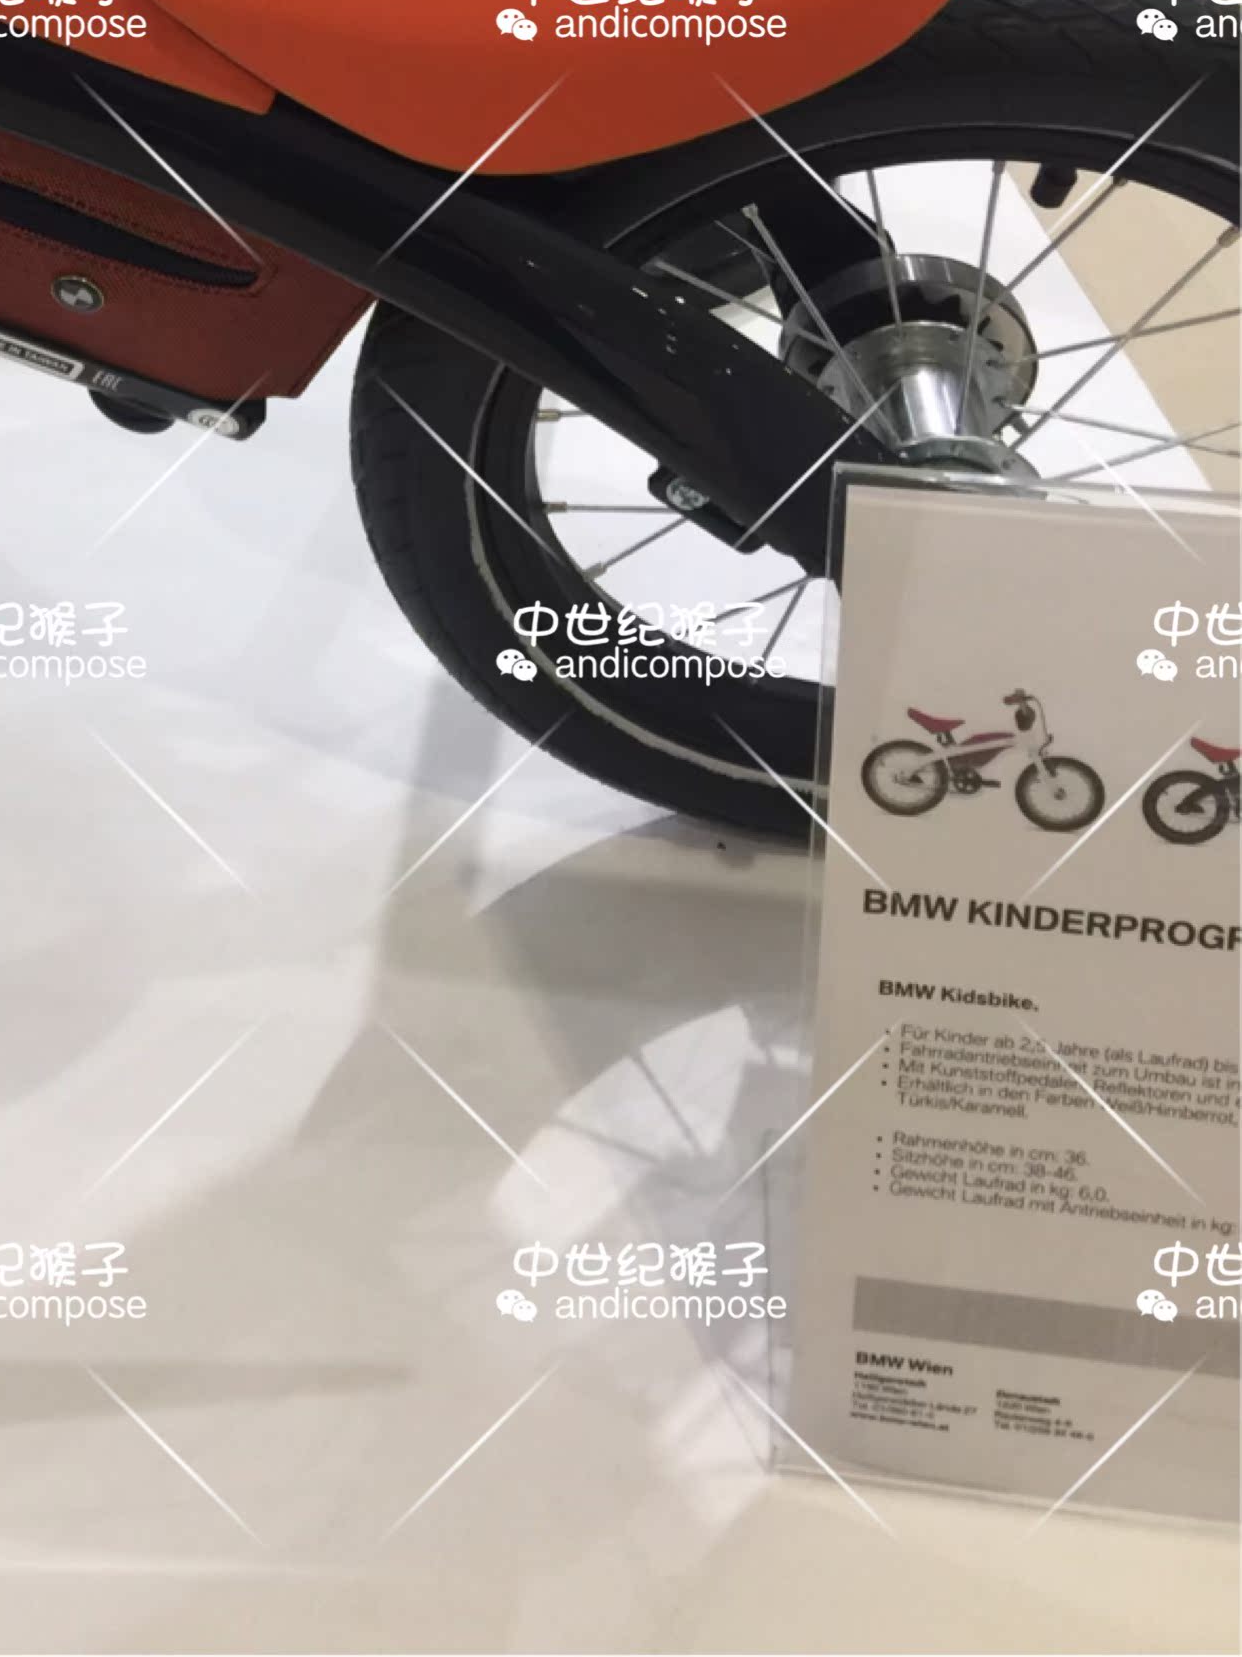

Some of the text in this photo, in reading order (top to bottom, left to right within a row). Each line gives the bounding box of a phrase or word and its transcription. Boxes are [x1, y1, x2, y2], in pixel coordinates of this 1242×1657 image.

[863, 888, 959, 922] BMW
[878, 979, 1039, 1013] BMW Kidsbike.
[900, 1023, 930, 1042] Für
[934, 1028, 989, 1046] Kinder
[1133, 1066, 1197, 1088] Umbau
[855, 1350, 954, 1377] BMW Wien
